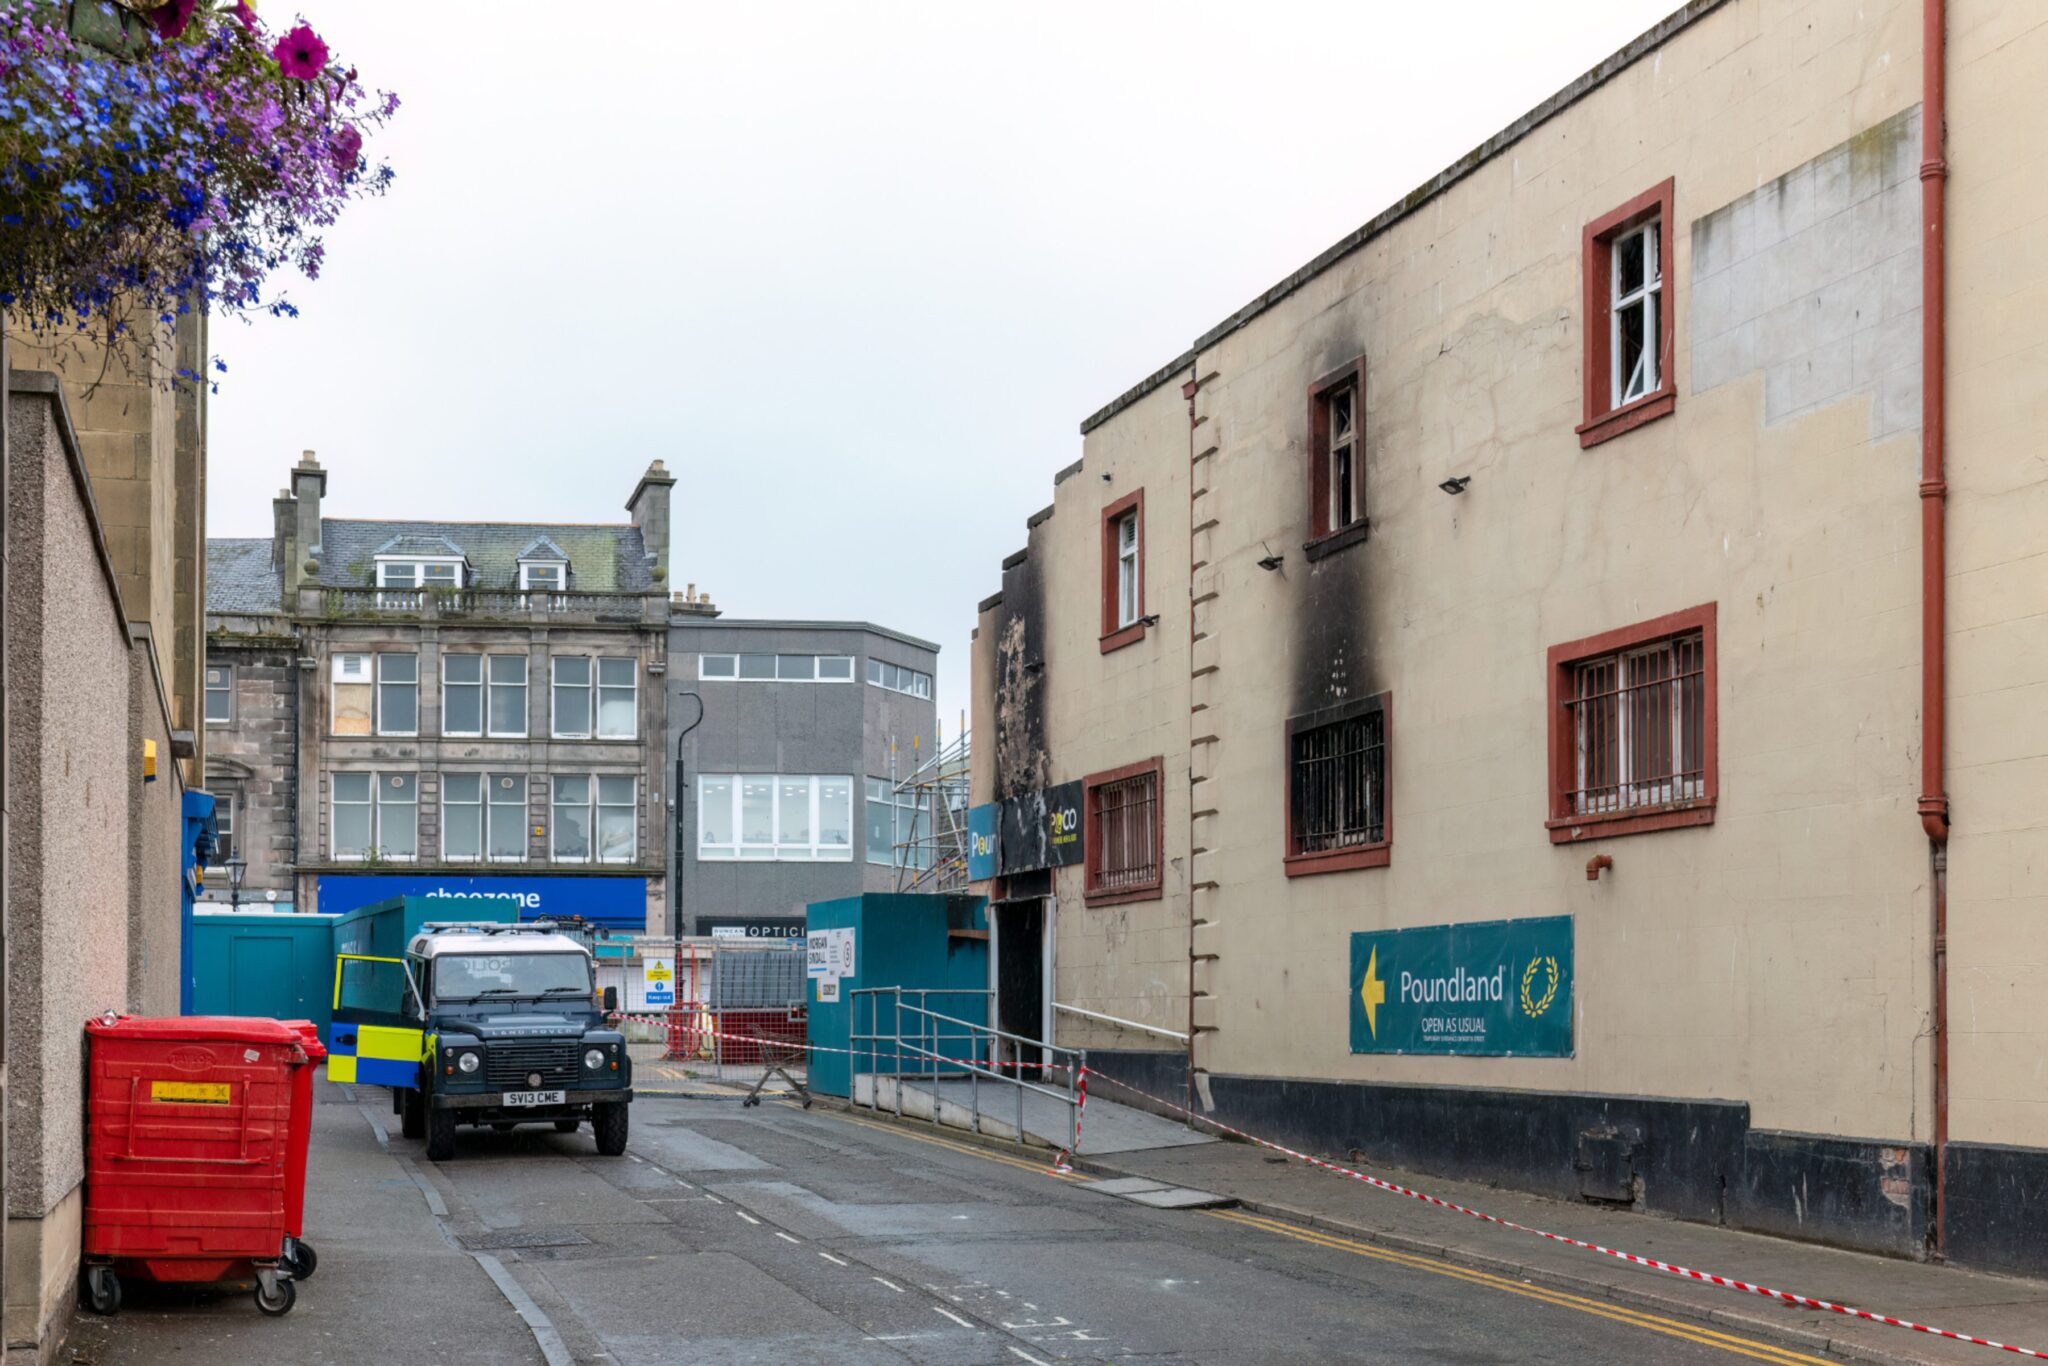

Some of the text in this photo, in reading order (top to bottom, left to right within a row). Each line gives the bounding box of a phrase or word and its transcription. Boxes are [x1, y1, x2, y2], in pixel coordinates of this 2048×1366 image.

[1401, 964, 1503, 1003] Poundland
[1421, 1017, 1487, 1033] OPEN AS USUAL
[510, 1092, 559, 1104] SV13 CME
